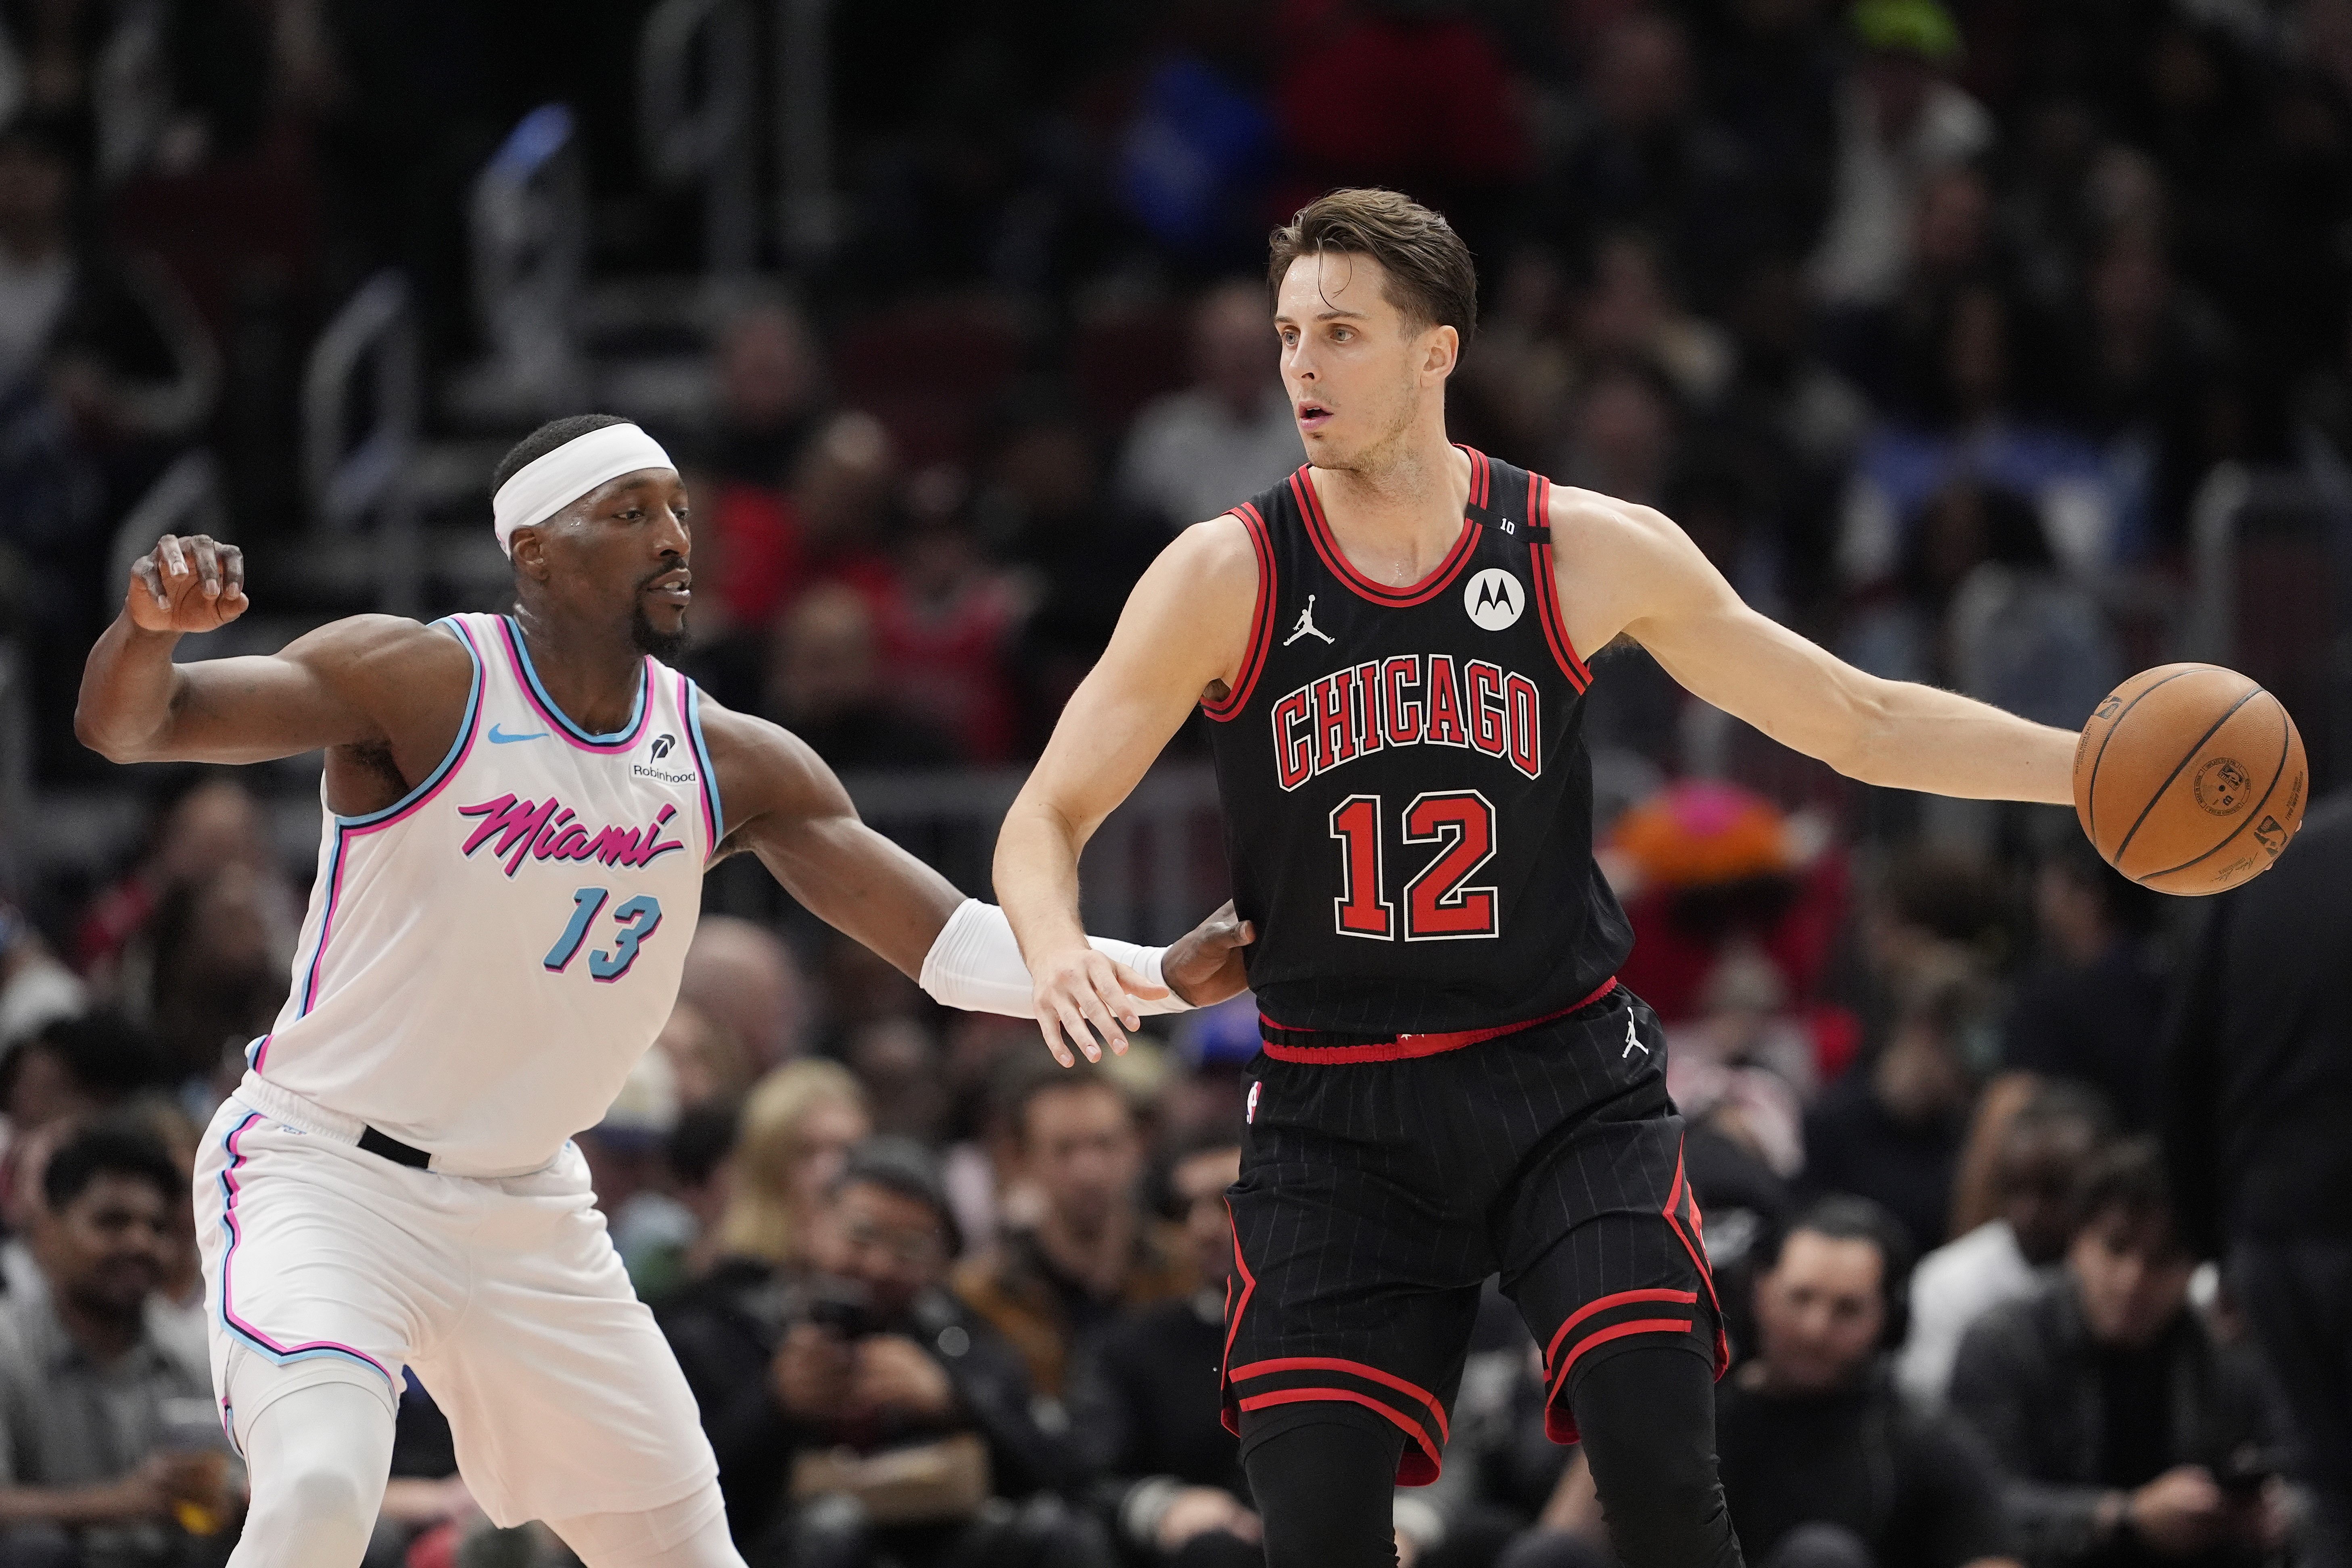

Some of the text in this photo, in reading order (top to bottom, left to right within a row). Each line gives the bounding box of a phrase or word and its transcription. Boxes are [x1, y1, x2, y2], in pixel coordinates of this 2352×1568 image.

[1500, 518, 1515, 535] 10
[1271, 654, 1541, 792] CHICAGO
[634, 765, 696, 782] Robinhood
[458, 793, 685, 877] Miami
[1330, 789, 1498, 941] 12
[543, 888, 662, 983] 13
